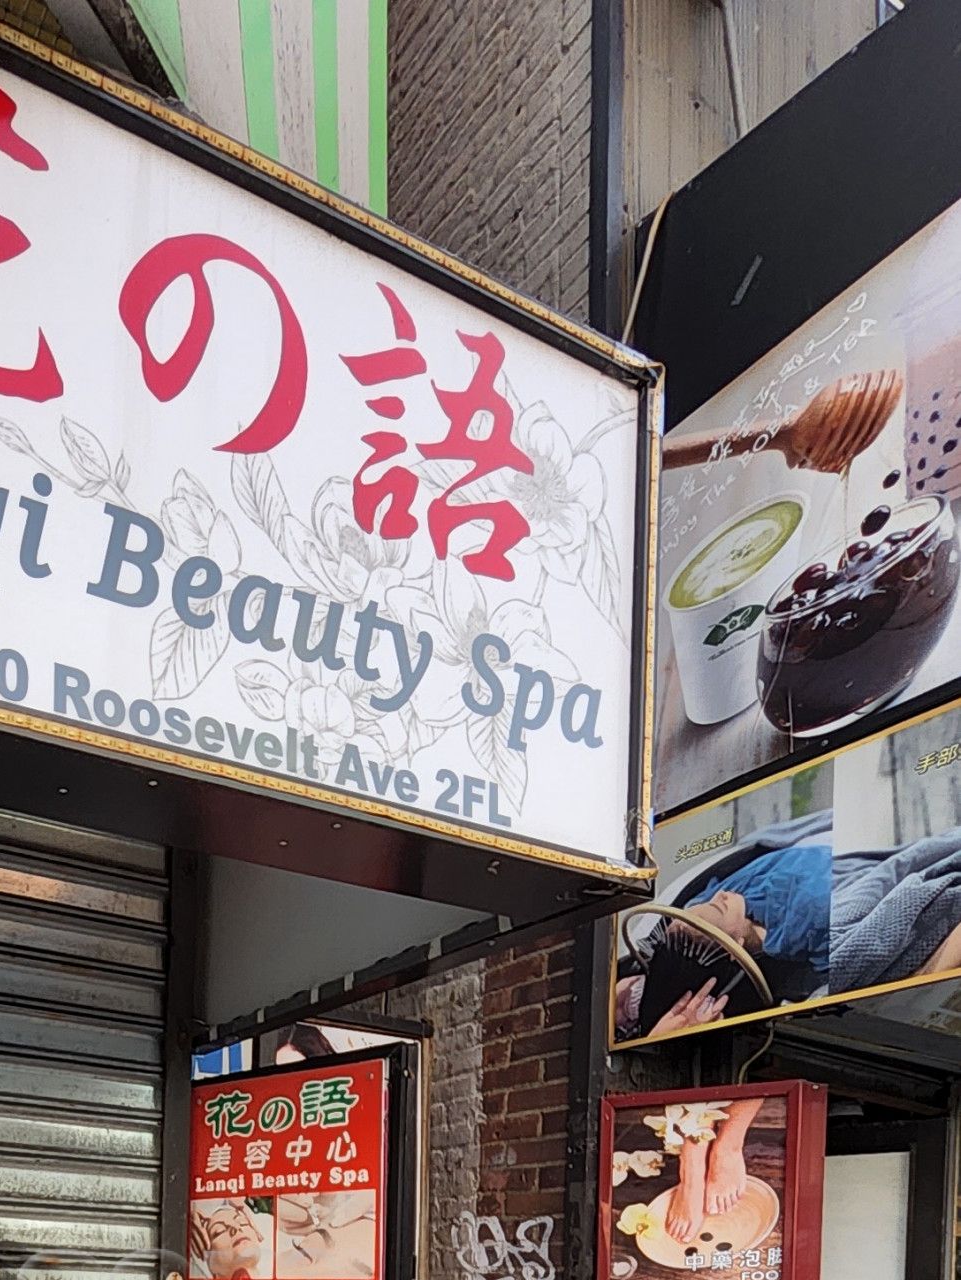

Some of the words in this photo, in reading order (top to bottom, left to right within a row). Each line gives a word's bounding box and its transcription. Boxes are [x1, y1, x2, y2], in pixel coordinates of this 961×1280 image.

[87, 505, 434, 711] Beauty
[461, 631, 604, 753] Spa
[51, 662, 320, 784] Roosevelt
[334, 741, 421, 806] Ave
[432, 769, 513, 828] 2FL
[205, 1077, 360, 1138] 花の語
[195, 1174, 245, 1194] Lanqi
[251, 1170, 322, 1190] Beauty
[329, 1166, 370, 1187] Spa
[205, 1131, 357, 1173] 美容中心
